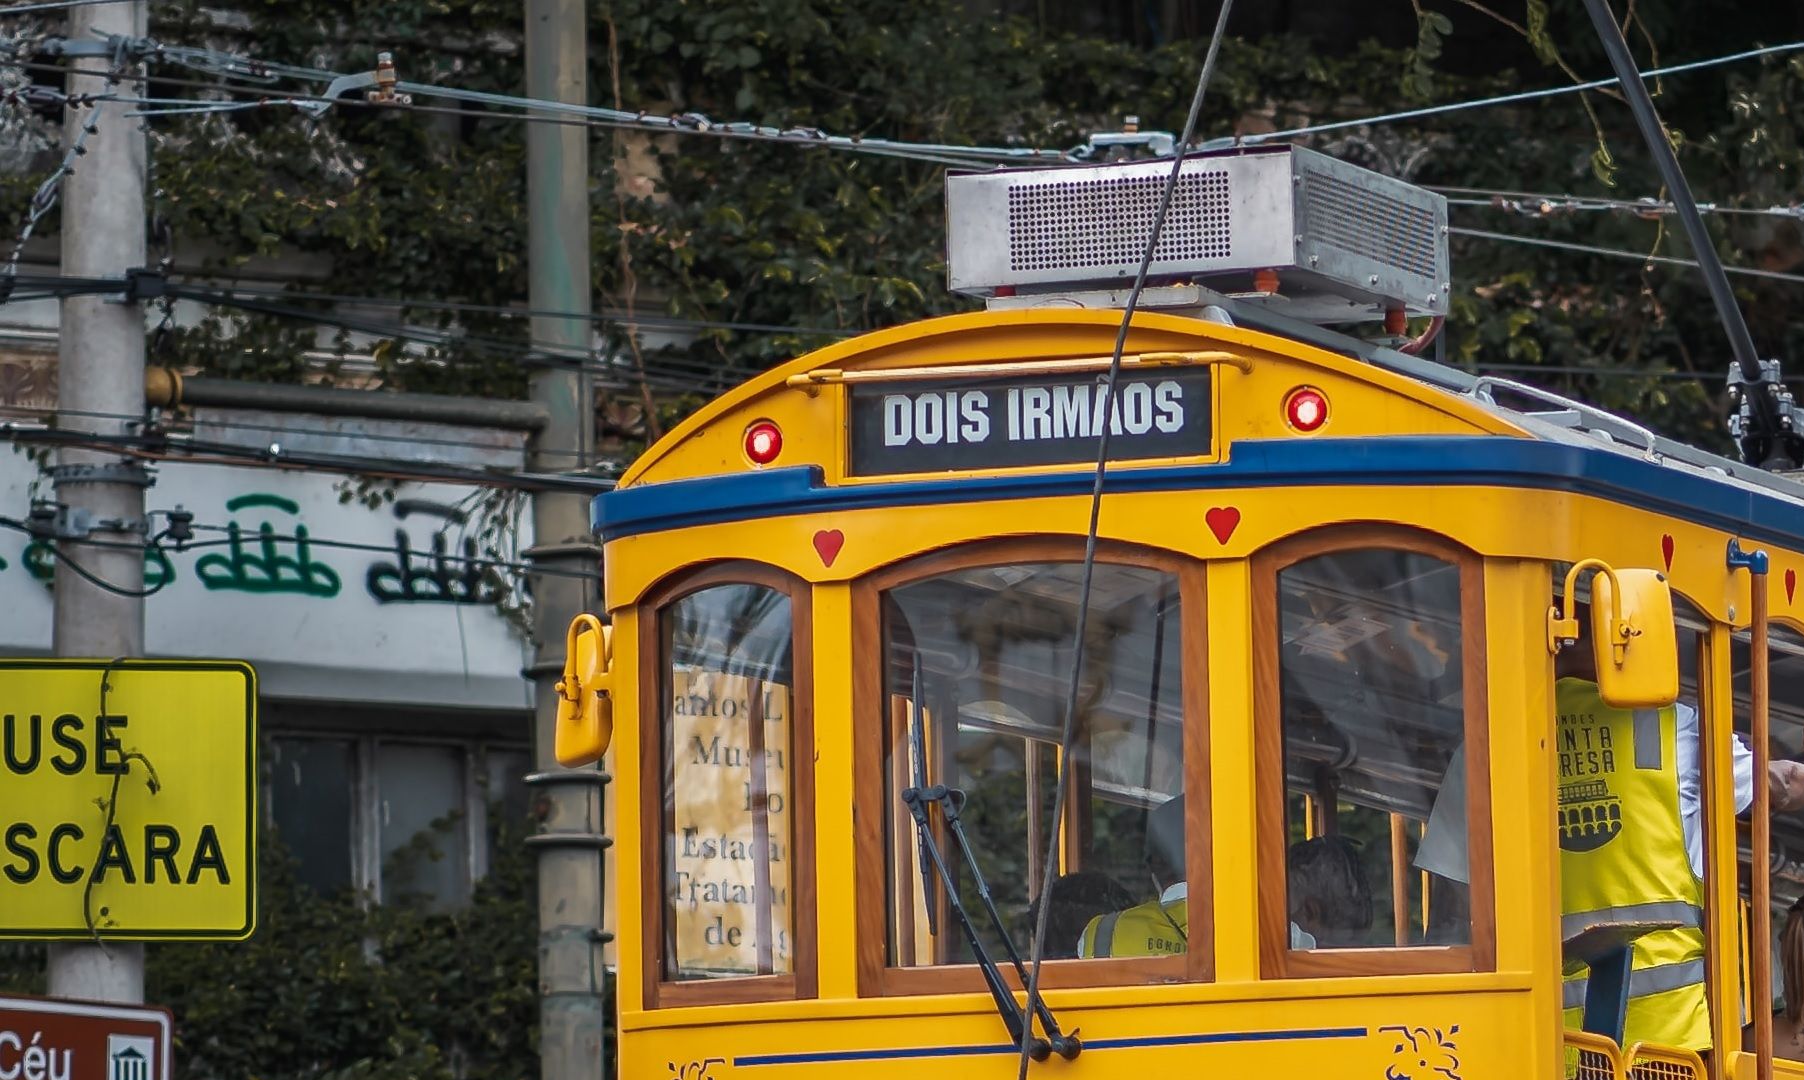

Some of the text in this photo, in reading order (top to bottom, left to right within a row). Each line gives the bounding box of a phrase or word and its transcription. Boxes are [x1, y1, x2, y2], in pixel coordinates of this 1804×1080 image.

[884, 390, 990, 446] DOIS
[4, 714, 129, 775] USE
[1556, 726, 1612, 752] NTA
[3, 822, 231, 884] SCARA
[675, 871, 785, 904] Trata
[1147, 937, 1187, 953] BOND
